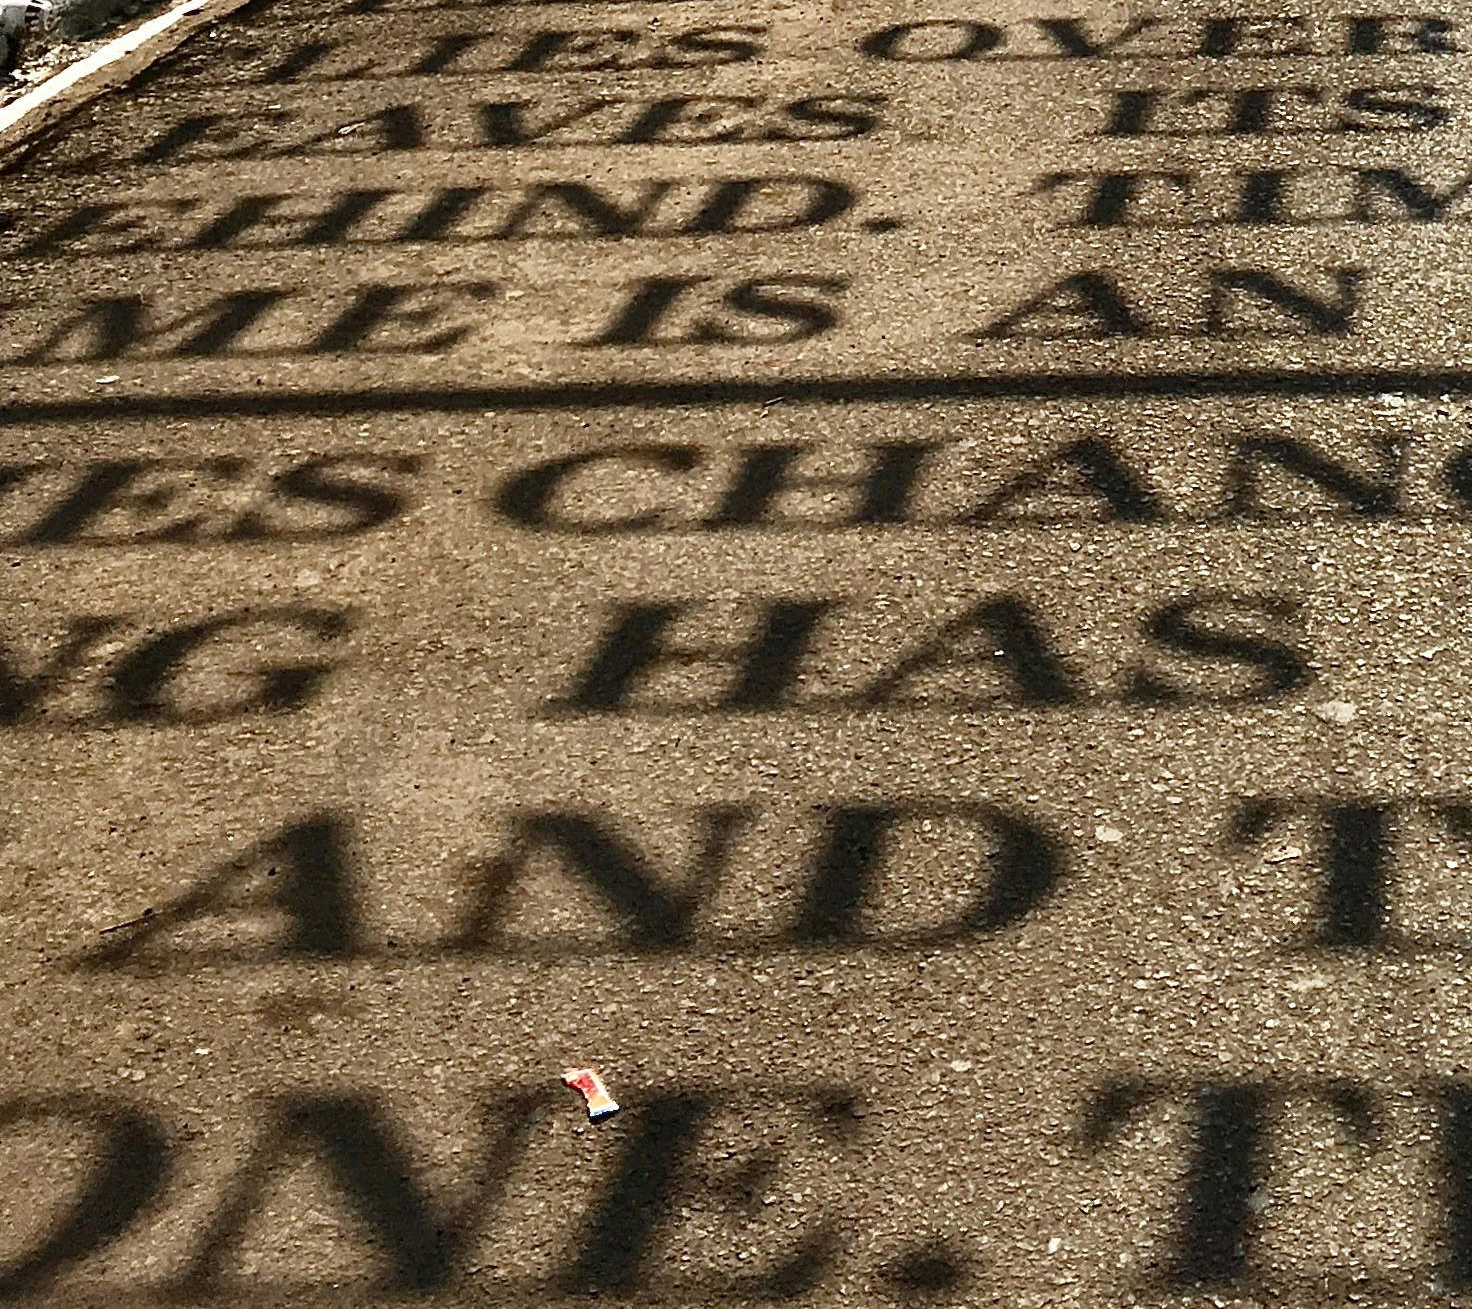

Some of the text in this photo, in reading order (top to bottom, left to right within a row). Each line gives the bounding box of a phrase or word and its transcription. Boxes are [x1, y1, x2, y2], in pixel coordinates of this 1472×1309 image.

[857, 15, 1465, 60] OVER
[1085, 85, 1454, 137] ITS
[575, 273, 848, 349] IS
[970, 267, 1368, 341] AN
[541, 588, 1318, 720] HAS
[69, 791, 1076, 969] AND
